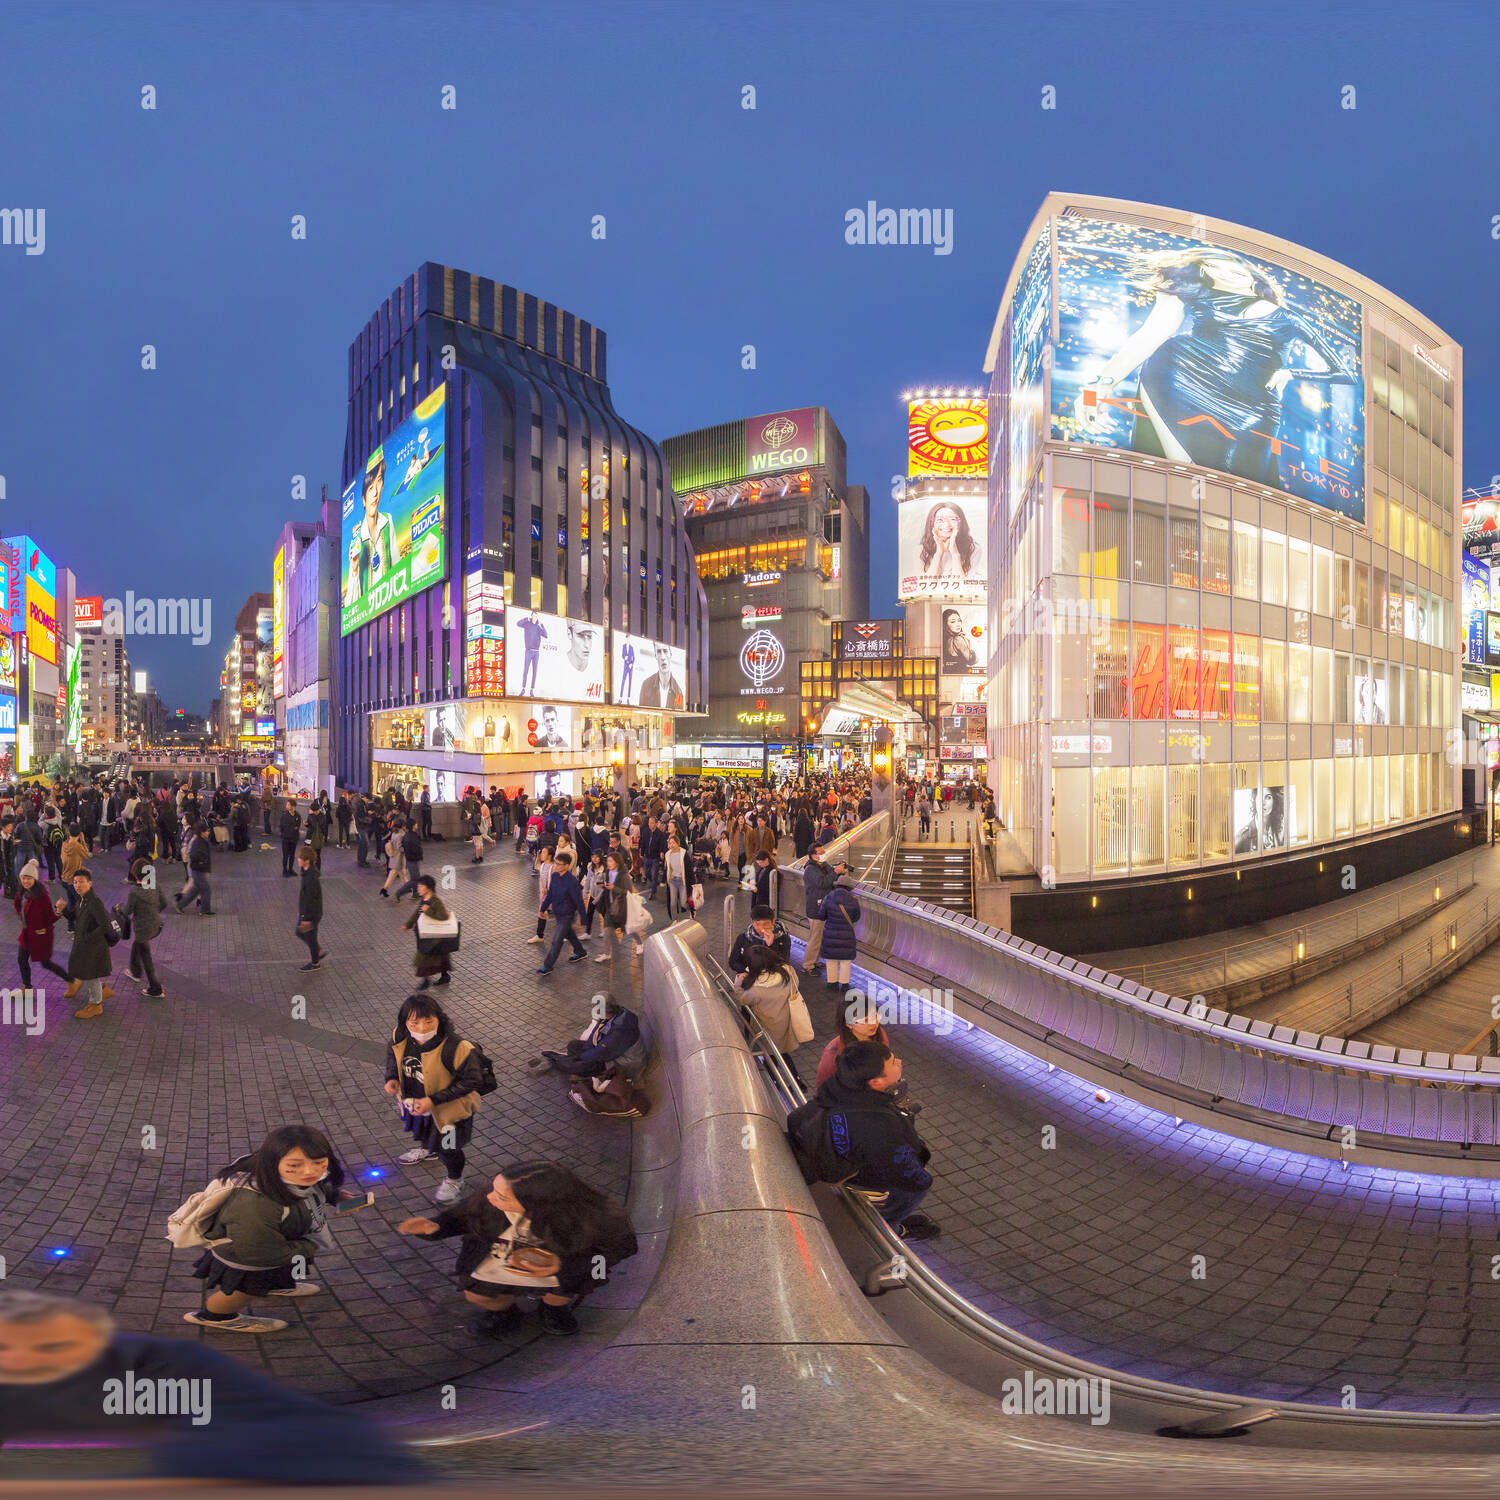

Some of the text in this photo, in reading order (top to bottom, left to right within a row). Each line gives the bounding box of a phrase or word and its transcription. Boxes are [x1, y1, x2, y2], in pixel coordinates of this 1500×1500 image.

[752, 447, 808, 470] WEGO
[1288, 464, 1350, 498] TOKYO
[412, 509, 440, 539] サロンパス
[368, 569, 409, 614] サロンパス
[919, 582, 960, 590] ワクワク
